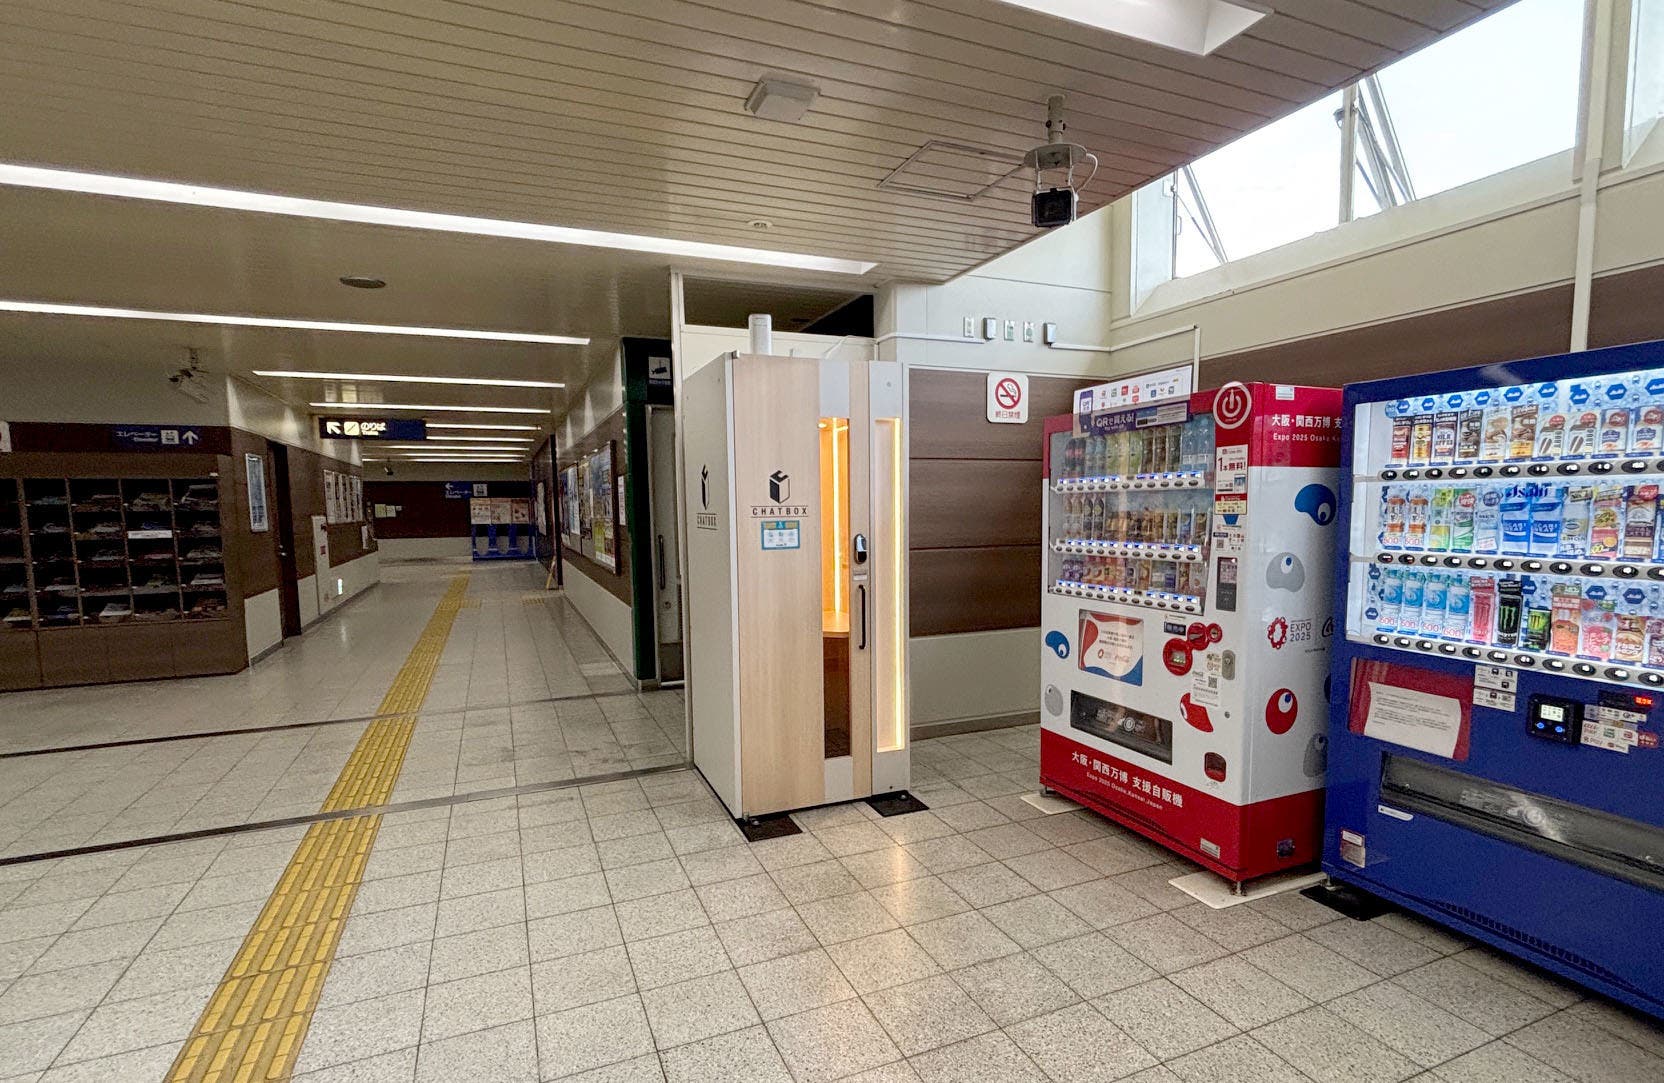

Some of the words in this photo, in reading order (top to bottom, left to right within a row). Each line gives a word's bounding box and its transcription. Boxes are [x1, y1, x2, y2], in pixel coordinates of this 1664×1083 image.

[1272, 414, 1331, 429] 大阪・関西万博
[1273, 432, 1290, 442] Expo
[1292, 433, 1308, 441] 2025
[752, 507, 808, 516] CHATBOX
[1290, 622, 1312, 633] EXPO
[1290, 632, 1312, 642] 2025
[1072, 751, 1128, 784] 大阪・関西万博
[1132, 776, 1184, 808] 支援自販機
